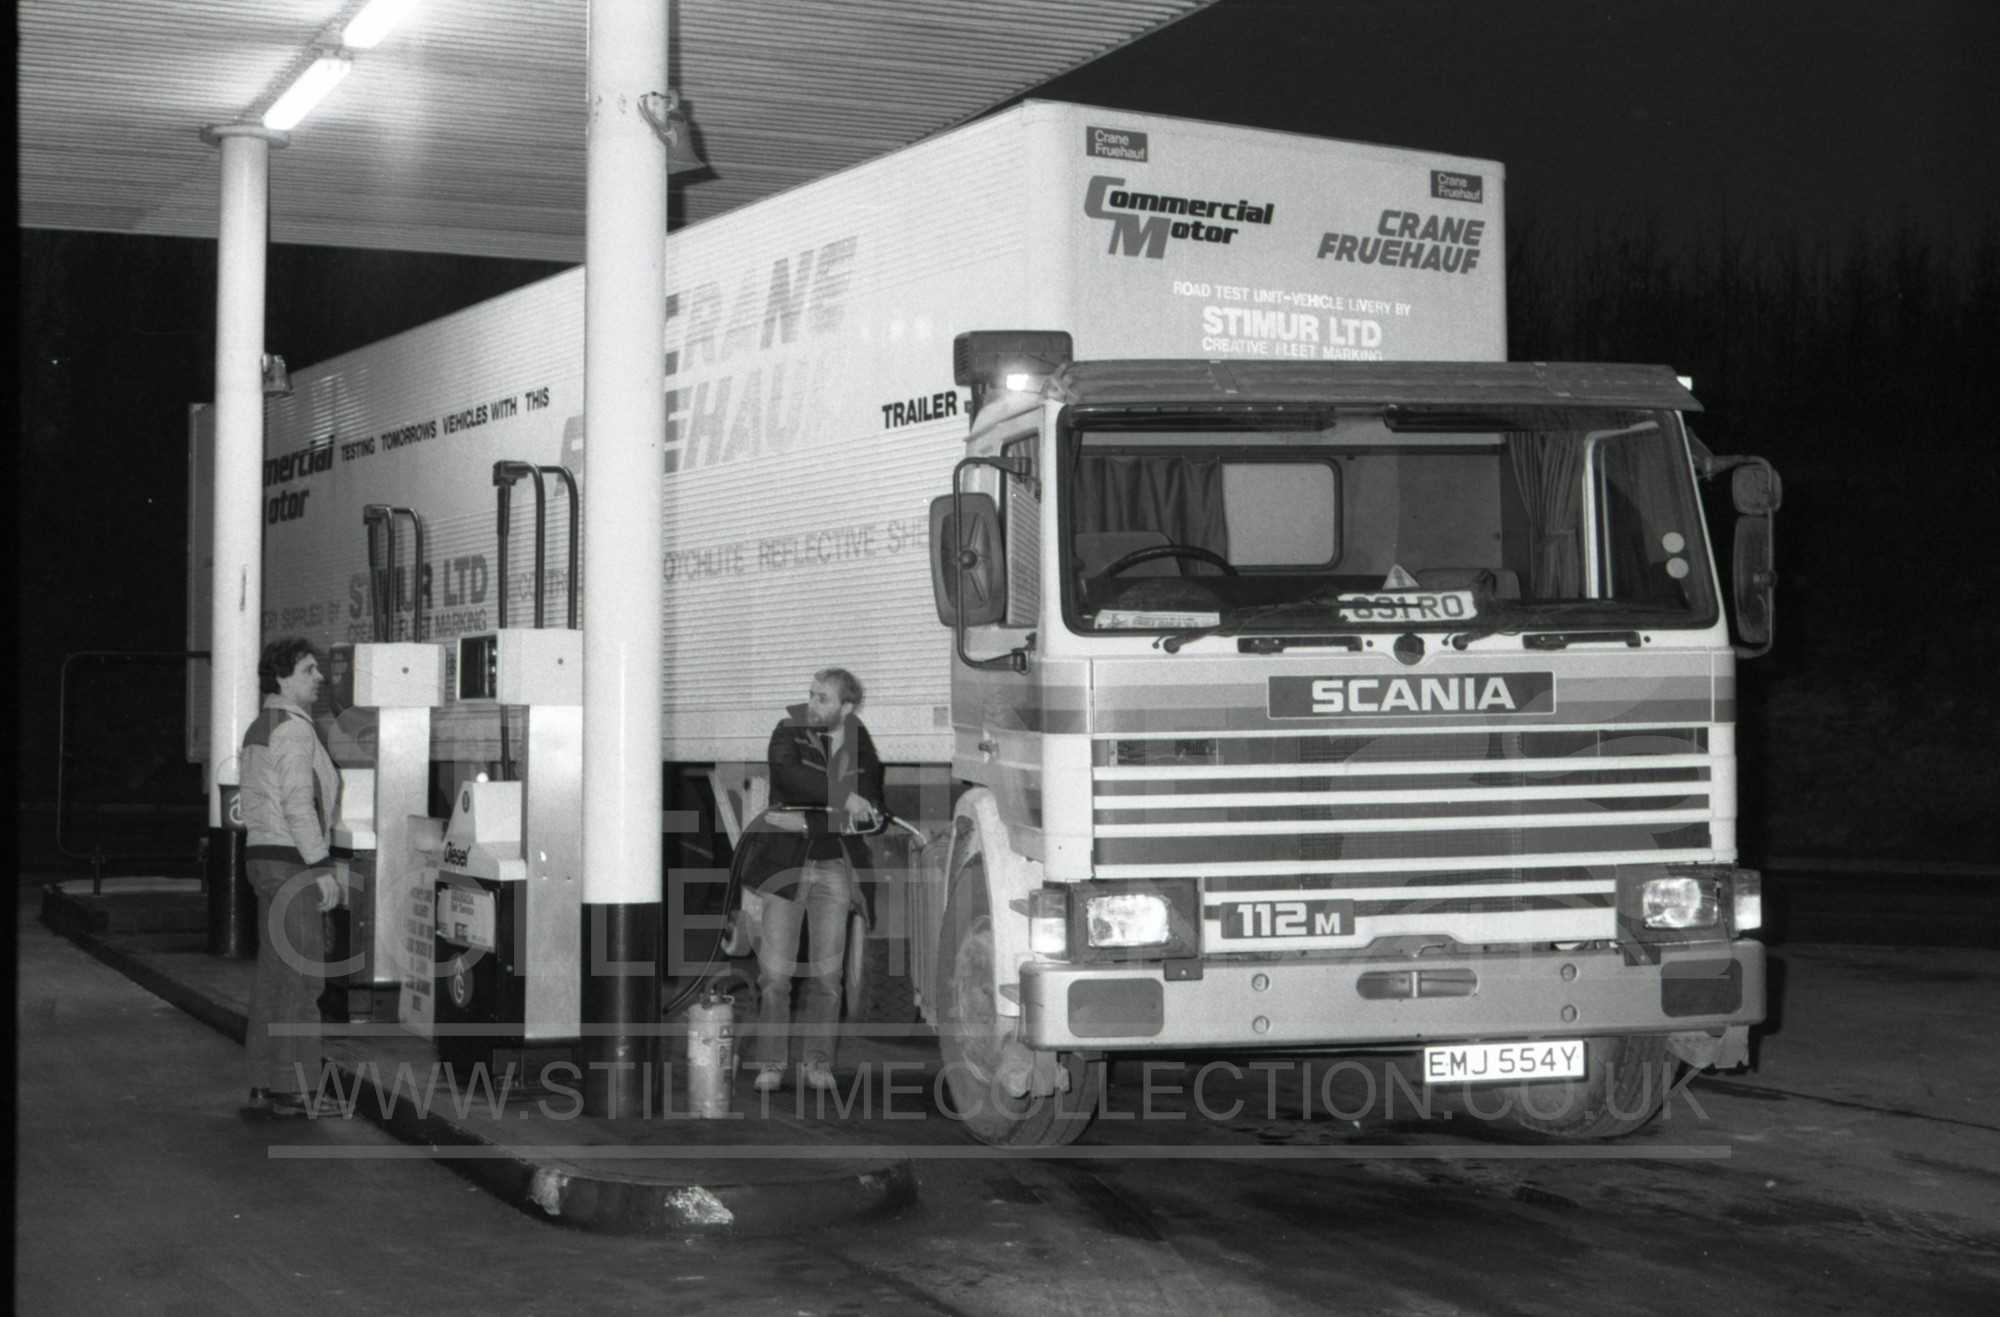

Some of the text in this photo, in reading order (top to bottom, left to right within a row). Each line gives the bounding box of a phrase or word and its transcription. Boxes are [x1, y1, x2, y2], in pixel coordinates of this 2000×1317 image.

[1095, 129, 1129, 146] Crane
[1095, 142, 1145, 160] Fruehauf
[1437, 173, 1468, 188] Crane
[1084, 175, 1274, 225] Commercial
[1108, 213, 1239, 259] Motor
[1377, 209, 1486, 246] CRANE
[1316, 232, 1481, 275] FRUEHAUF
[1172, 281, 1212, 297] ROAD
[1215, 285, 1250, 301] TEST
[1349, 298, 1392, 315] LIVERY
[1395, 302, 1413, 317] BY
[1202, 305, 1383, 349] STIMUR LTD
[1202, 336, 1269, 356] CREATIVE
[1275, 341, 1316, 358] FLEET
[340, 437, 376, 463] TESTING
[380, 419, 438, 452] TOMORROWS
[442, 404, 489, 435] VEHICLES
[490, 396, 518, 421] WITH
[525, 386, 550, 411] THIS
[881, 390, 957, 430] TRAILER
[759, 525, 876, 572] REFLECTIVE
[443, 555, 488, 607] LTD
[1312, 677, 1516, 714] SCANIA
[444, 841, 472, 868] Diesel
[1236, 903, 1307, 936] 112
[1429, 1046, 1577, 1077] EMJ 554Y
